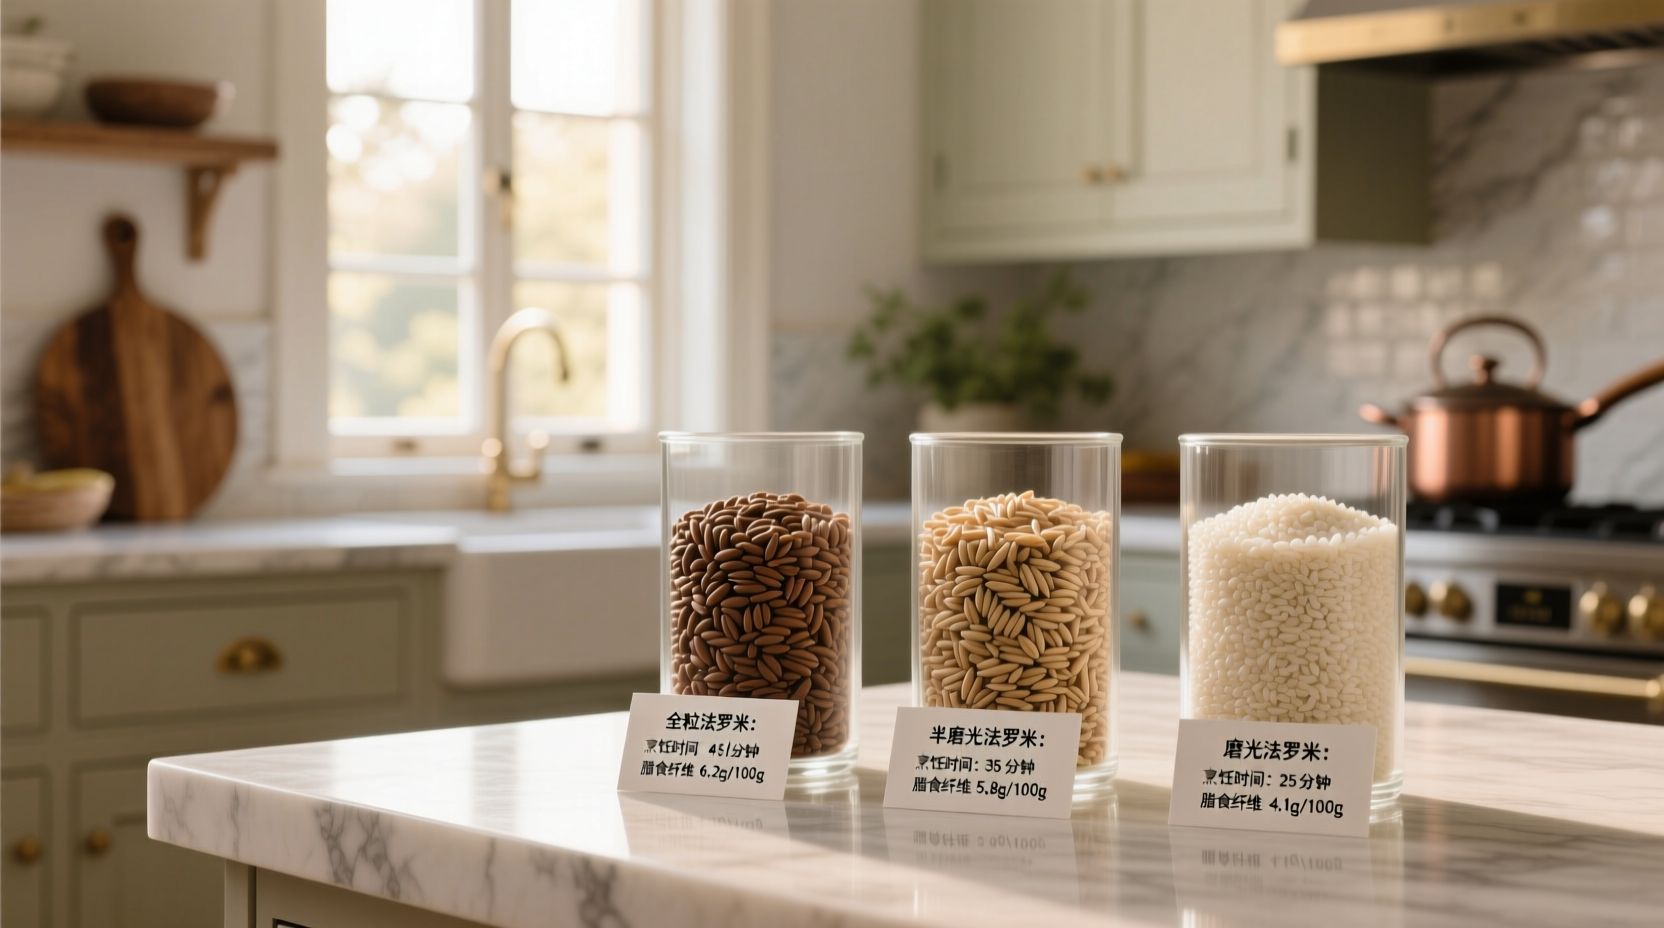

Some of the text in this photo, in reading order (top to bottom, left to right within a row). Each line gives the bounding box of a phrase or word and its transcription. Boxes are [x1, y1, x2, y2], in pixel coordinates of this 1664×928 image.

[699, 764, 765, 784] 6.2g/100g
[976, 780, 1048, 801] 5.8g/100g
[1268, 797, 1344, 818] 4.1g/100g
